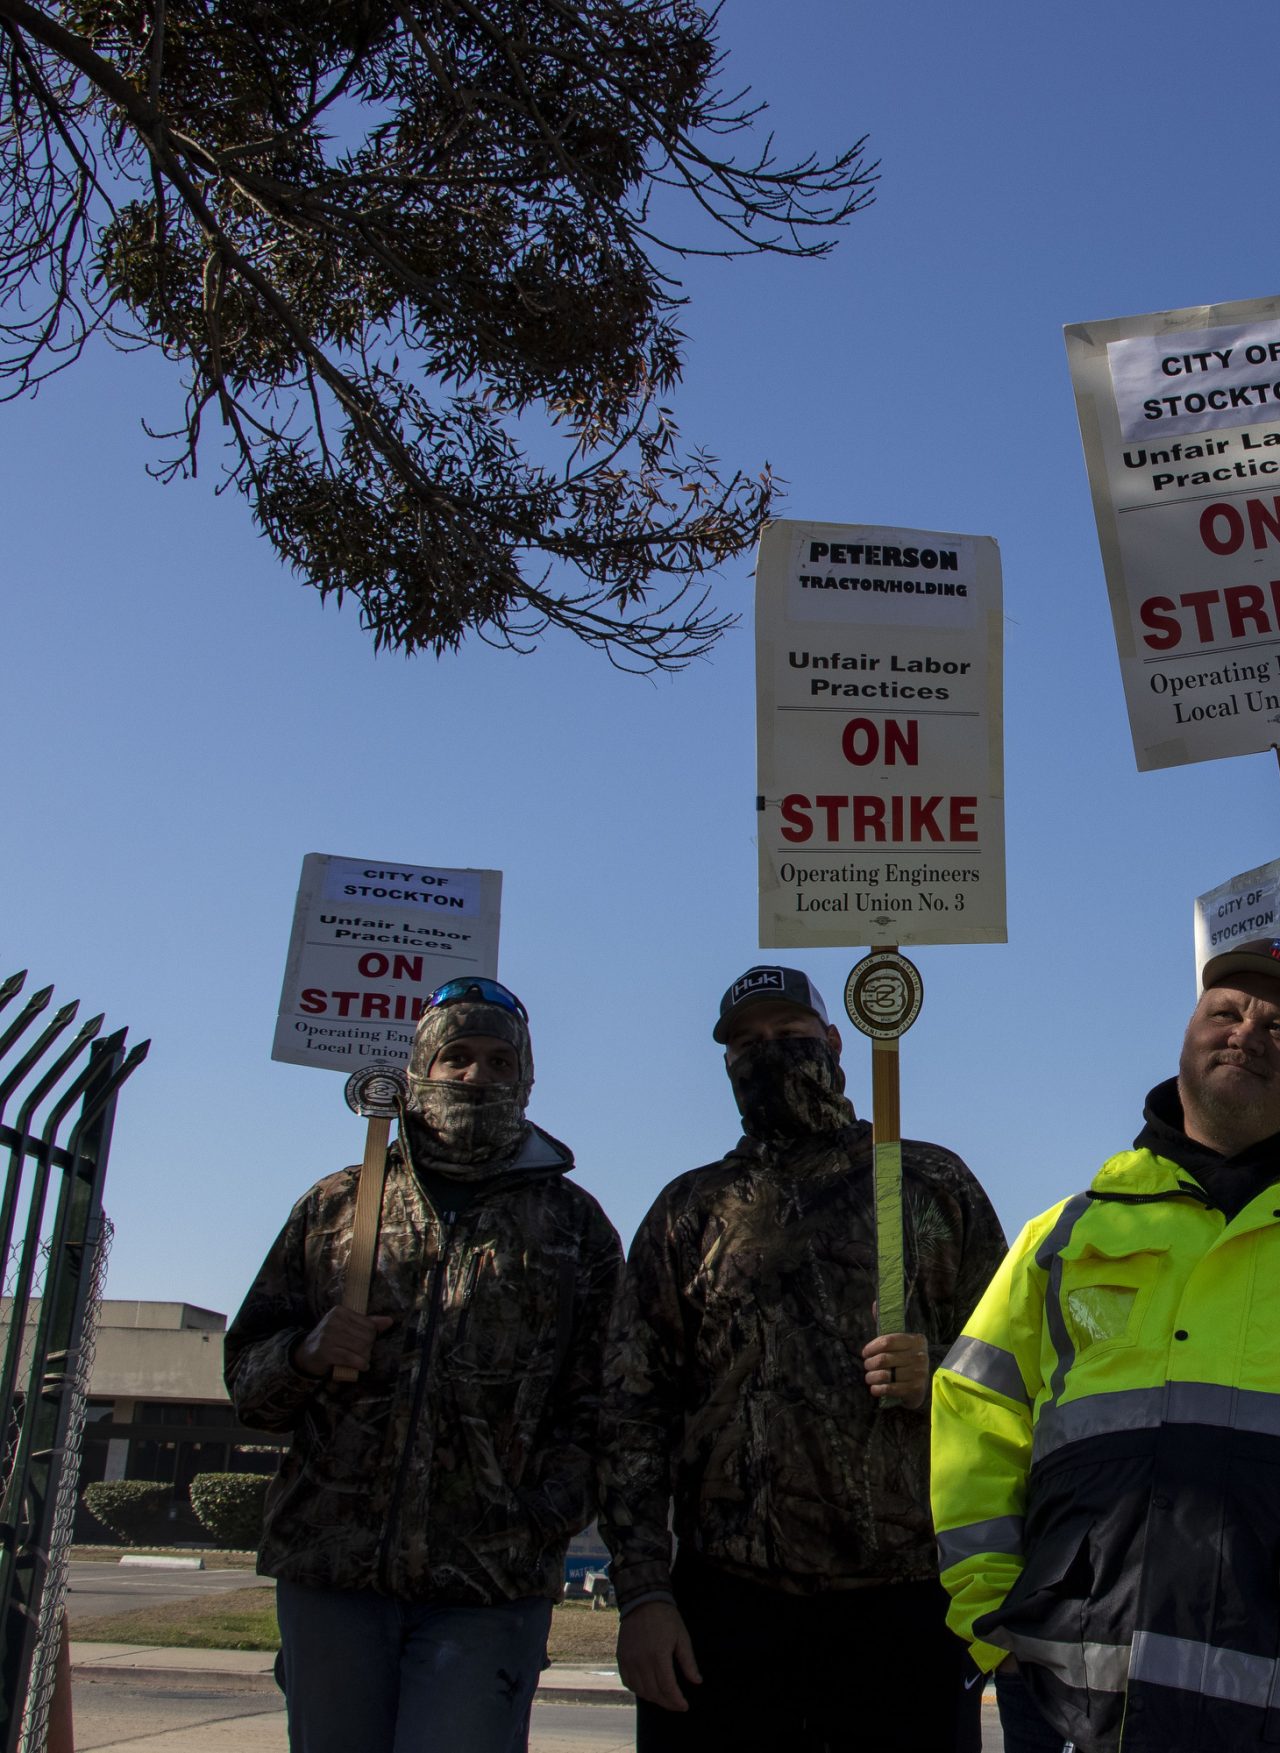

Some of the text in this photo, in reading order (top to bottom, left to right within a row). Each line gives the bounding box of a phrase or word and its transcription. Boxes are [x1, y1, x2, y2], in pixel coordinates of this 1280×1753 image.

[1161, 349, 1233, 377] CITY
[1122, 438, 1230, 469] Unfair
[809, 541, 959, 572] PETERSON
[799, 575, 968, 597] TRACTOR/HOLDING
[788, 651, 972, 675] Unfair Labor
[810, 678, 950, 701] Practices
[1150, 661, 1271, 697] Operating
[1173, 694, 1239, 724] Local
[841, 717, 919, 766] ON
[780, 793, 979, 843] STRIKE
[363, 869, 449, 886] CITY OF
[780, 862, 980, 887] Operating Engineers
[343, 884, 464, 909] STOCKTON
[796, 892, 965, 912] Local Union No. 3
[1218, 890, 1262, 918] CITY OF
[319, 914, 472, 942] Unfair Labor
[334, 929, 453, 950] Practices
[1211, 911, 1273, 946] STOCKTON
[357, 952, 424, 982] ON
[294, 1021, 381, 1042] Operating
[306, 1038, 410, 1060] Local Union
